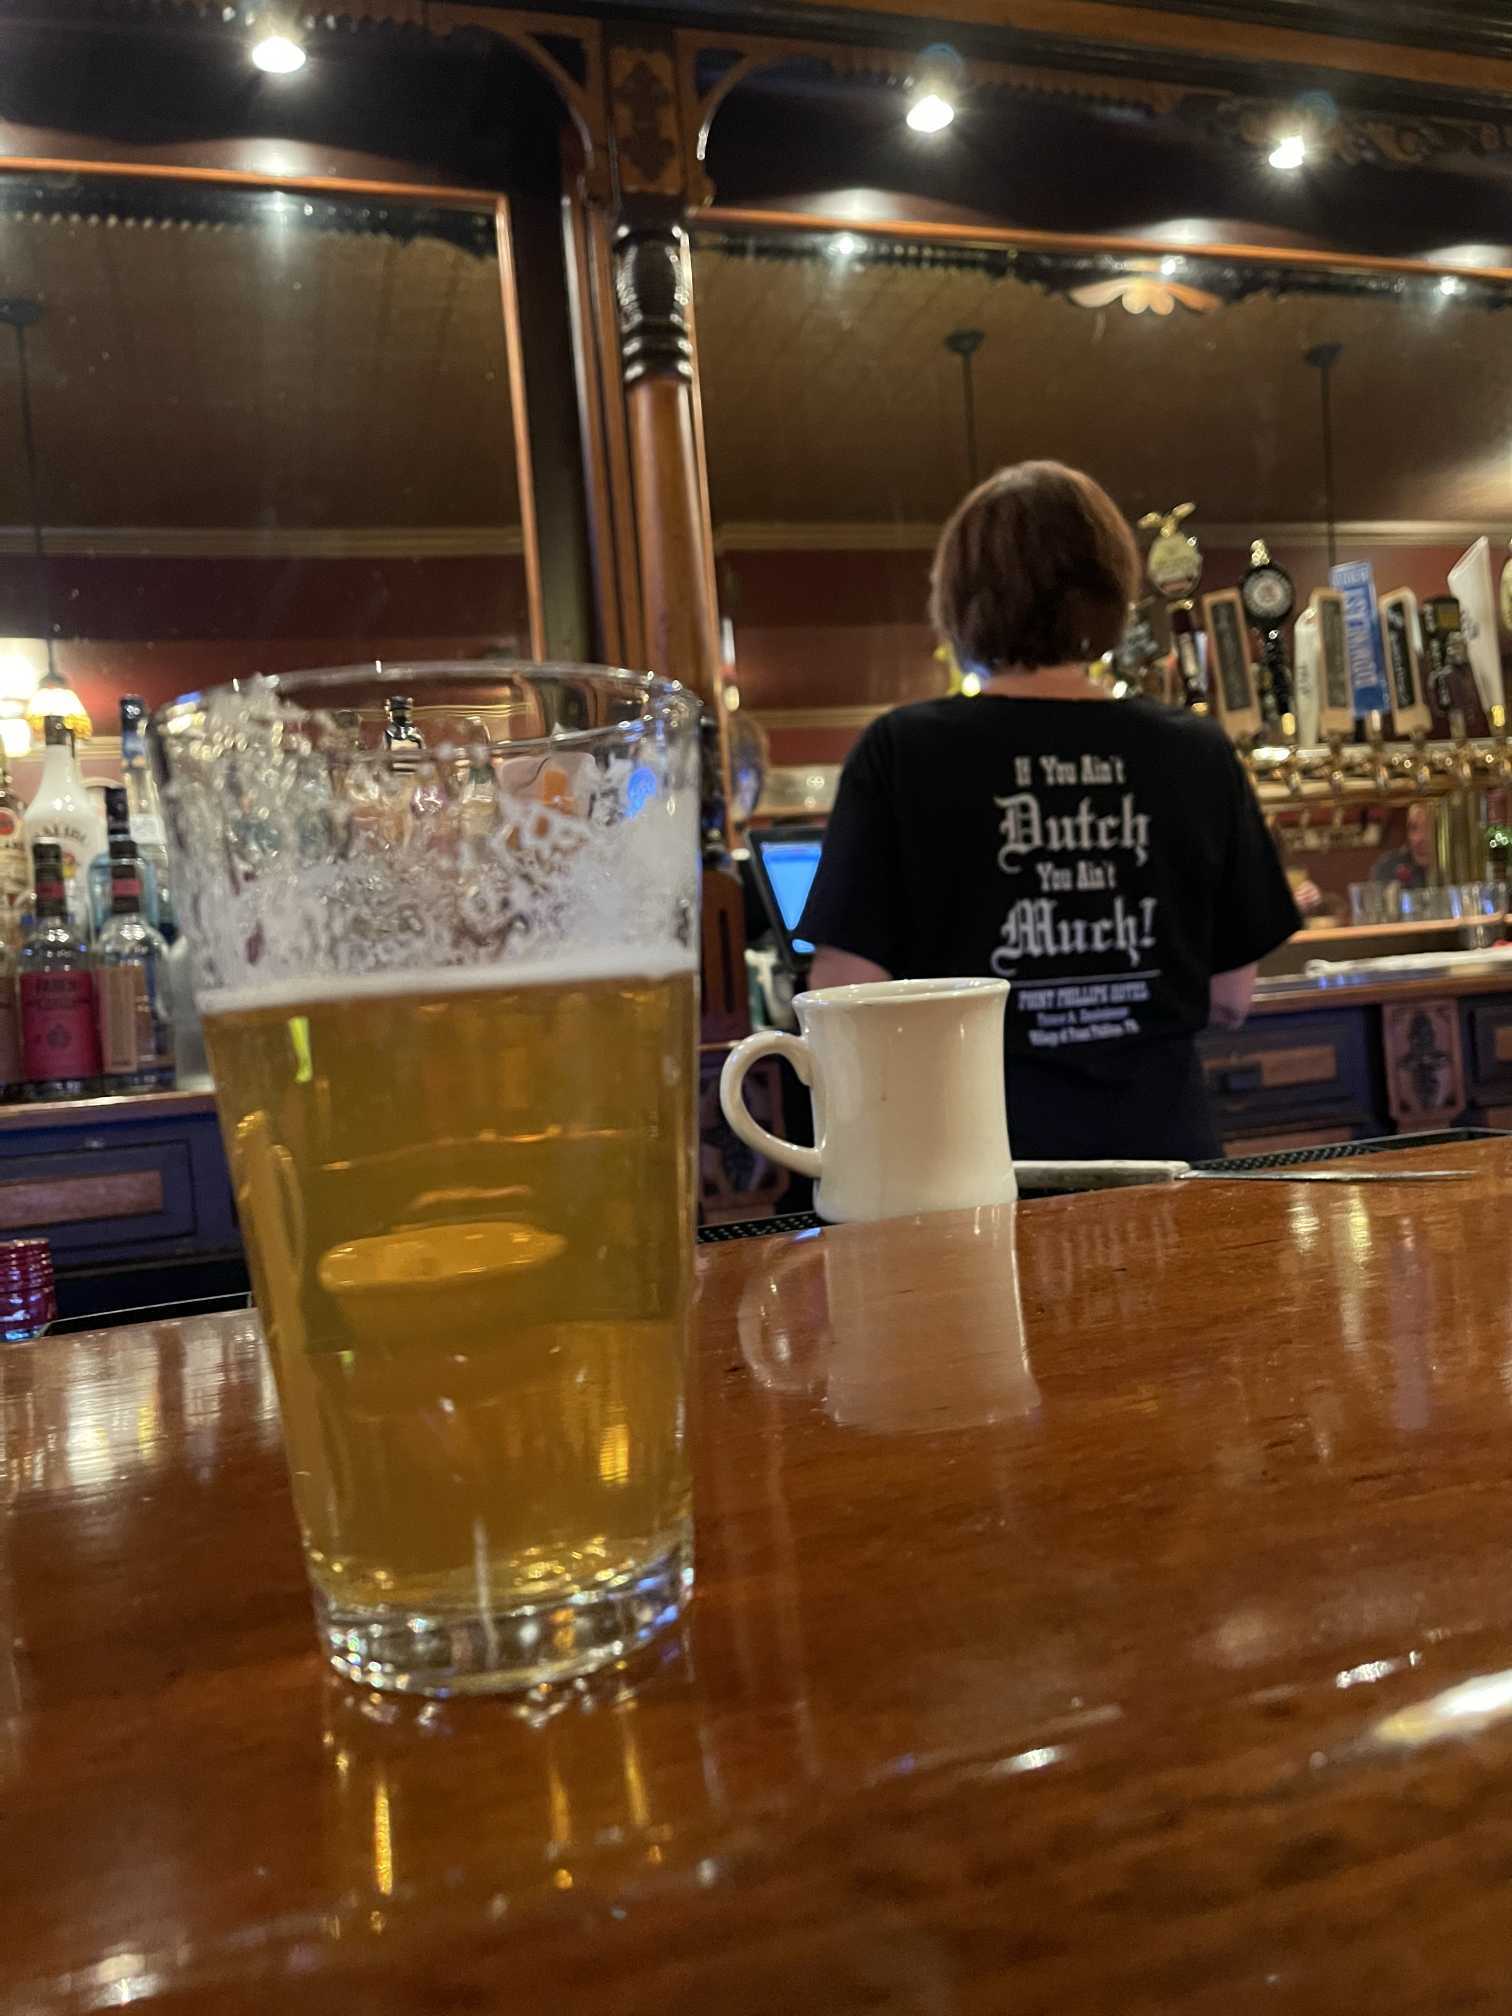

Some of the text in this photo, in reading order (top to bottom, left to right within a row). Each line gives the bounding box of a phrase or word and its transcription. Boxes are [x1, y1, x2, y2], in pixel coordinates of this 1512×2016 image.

[1040, 755, 1077, 785] You
[994, 792, 1151, 872] Dutch
[1036, 862, 1073, 891] You
[990, 896, 1157, 977] Much!
